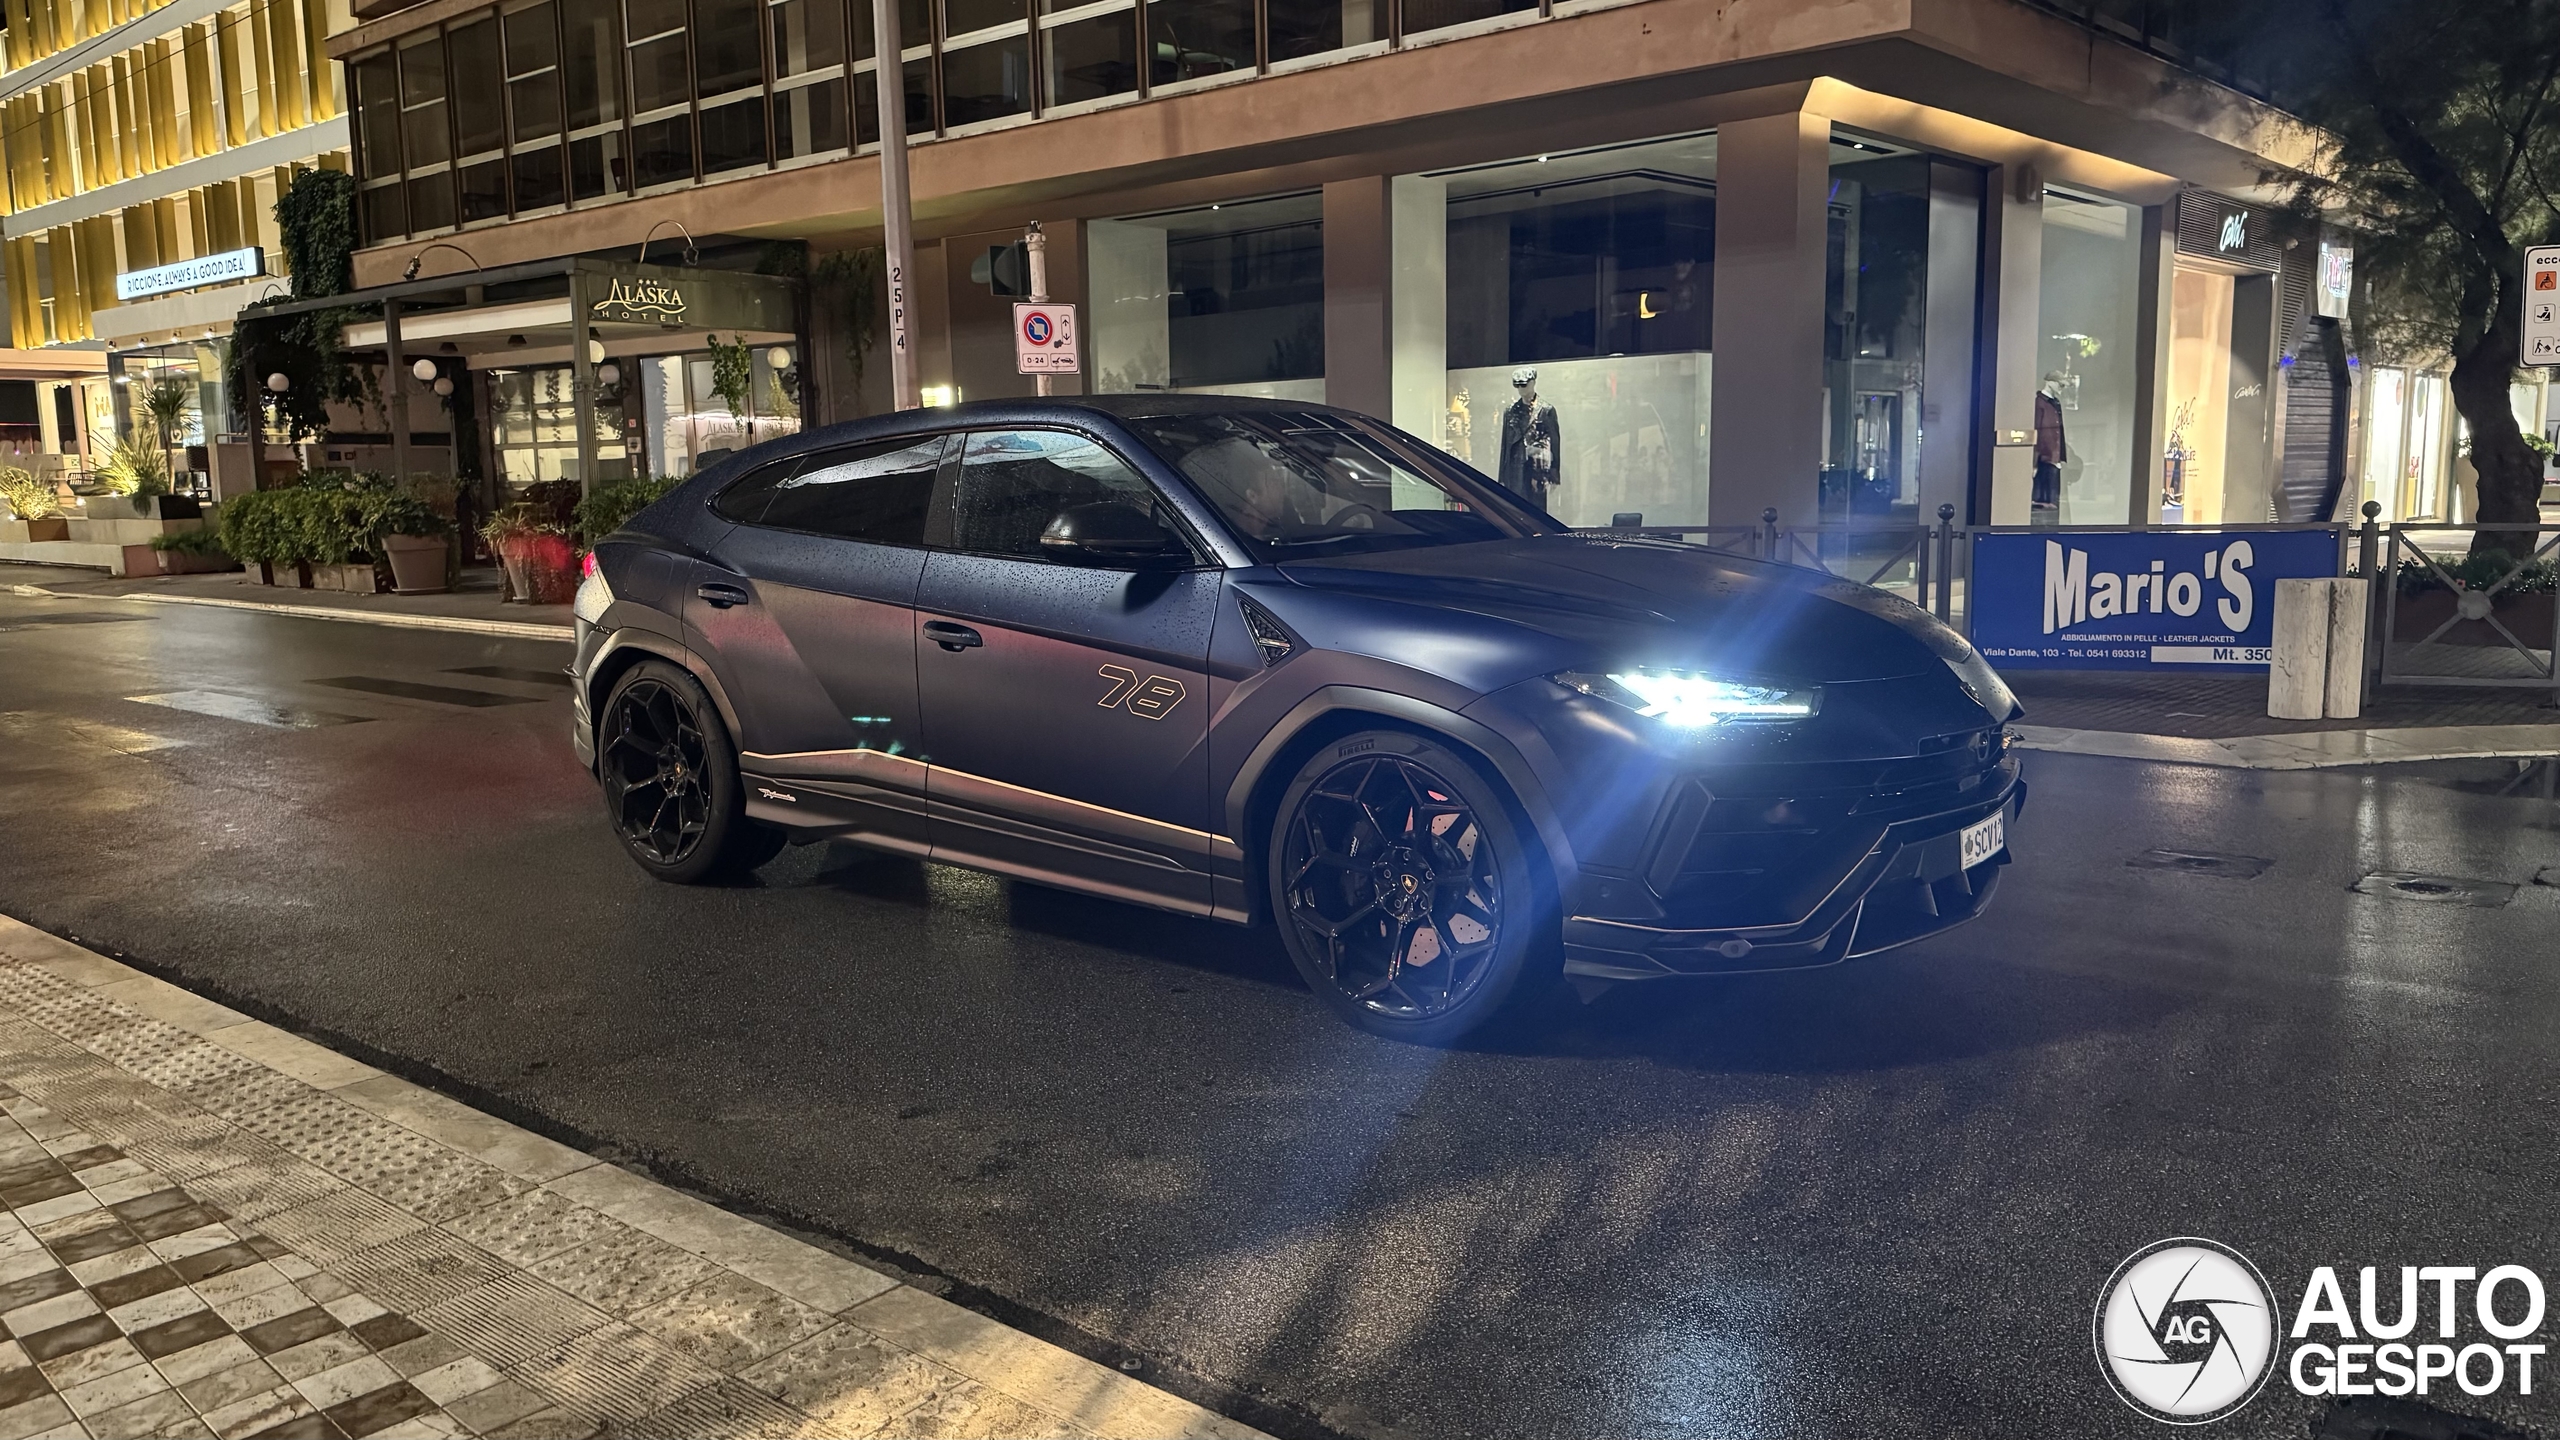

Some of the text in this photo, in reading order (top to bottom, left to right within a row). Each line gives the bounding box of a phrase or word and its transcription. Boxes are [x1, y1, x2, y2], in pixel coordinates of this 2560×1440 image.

[165, 267, 191, 285] ALWAYS
[193, 270, 199, 280] A
[200, 261, 224, 279] GOOD
[225, 257, 244, 274] IDEA
[594, 278, 685, 311] ALASKA
[602, 311, 684, 323] HOTEL
[2043, 539, 2254, 635] Mario'S
[2061, 634, 2122, 642] ABBIGLIAMENTO
[1983, 648, 2006, 657] Viale
[2009, 649, 2040, 658] Dante,
[2042, 649, 2059, 657] 103
[2068, 649, 2085, 657] Tel.
[2086, 649, 2109, 658] 0541
[2112, 650, 2147, 658] 693312
[2213, 648, 2239, 661] Mt.
[1098, 663, 1186, 720] 78
